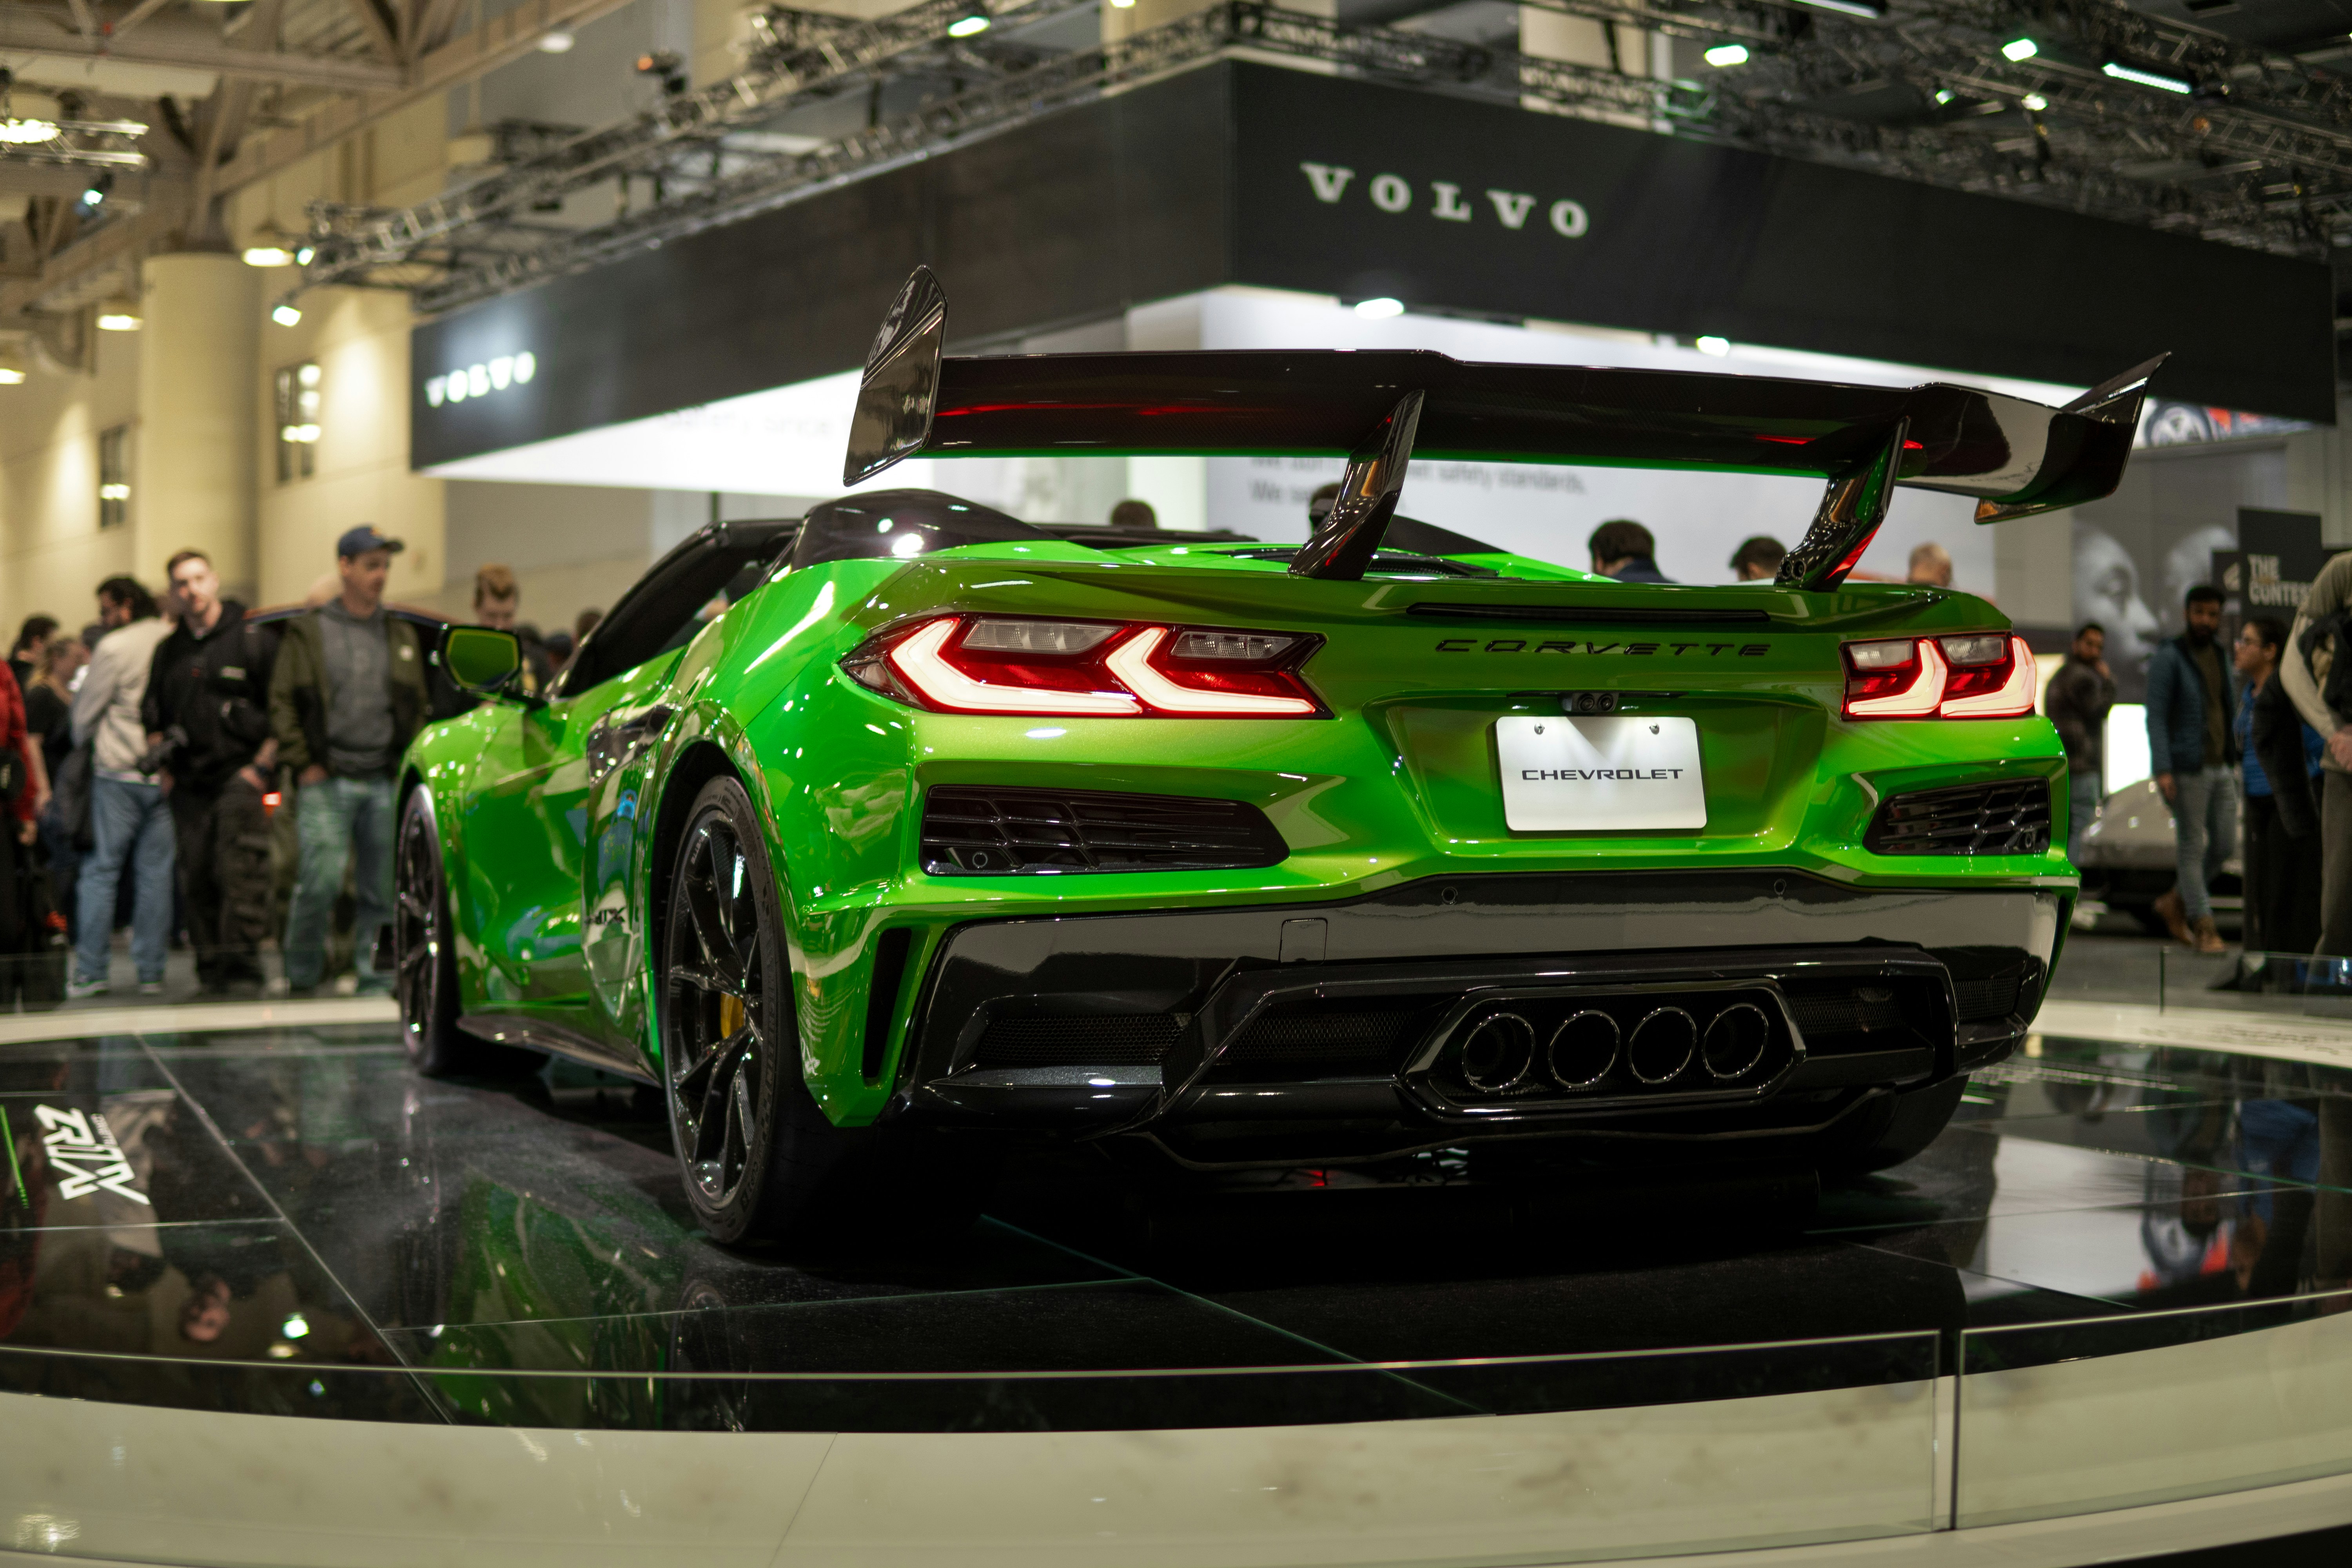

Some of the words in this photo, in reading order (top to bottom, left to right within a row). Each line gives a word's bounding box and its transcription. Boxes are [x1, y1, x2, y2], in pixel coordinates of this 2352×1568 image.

[1300, 162, 1589, 237] VOLVO
[1435, 639, 1771, 657] CORVETTE
[1522, 768, 1683, 780] CHEVROLET
